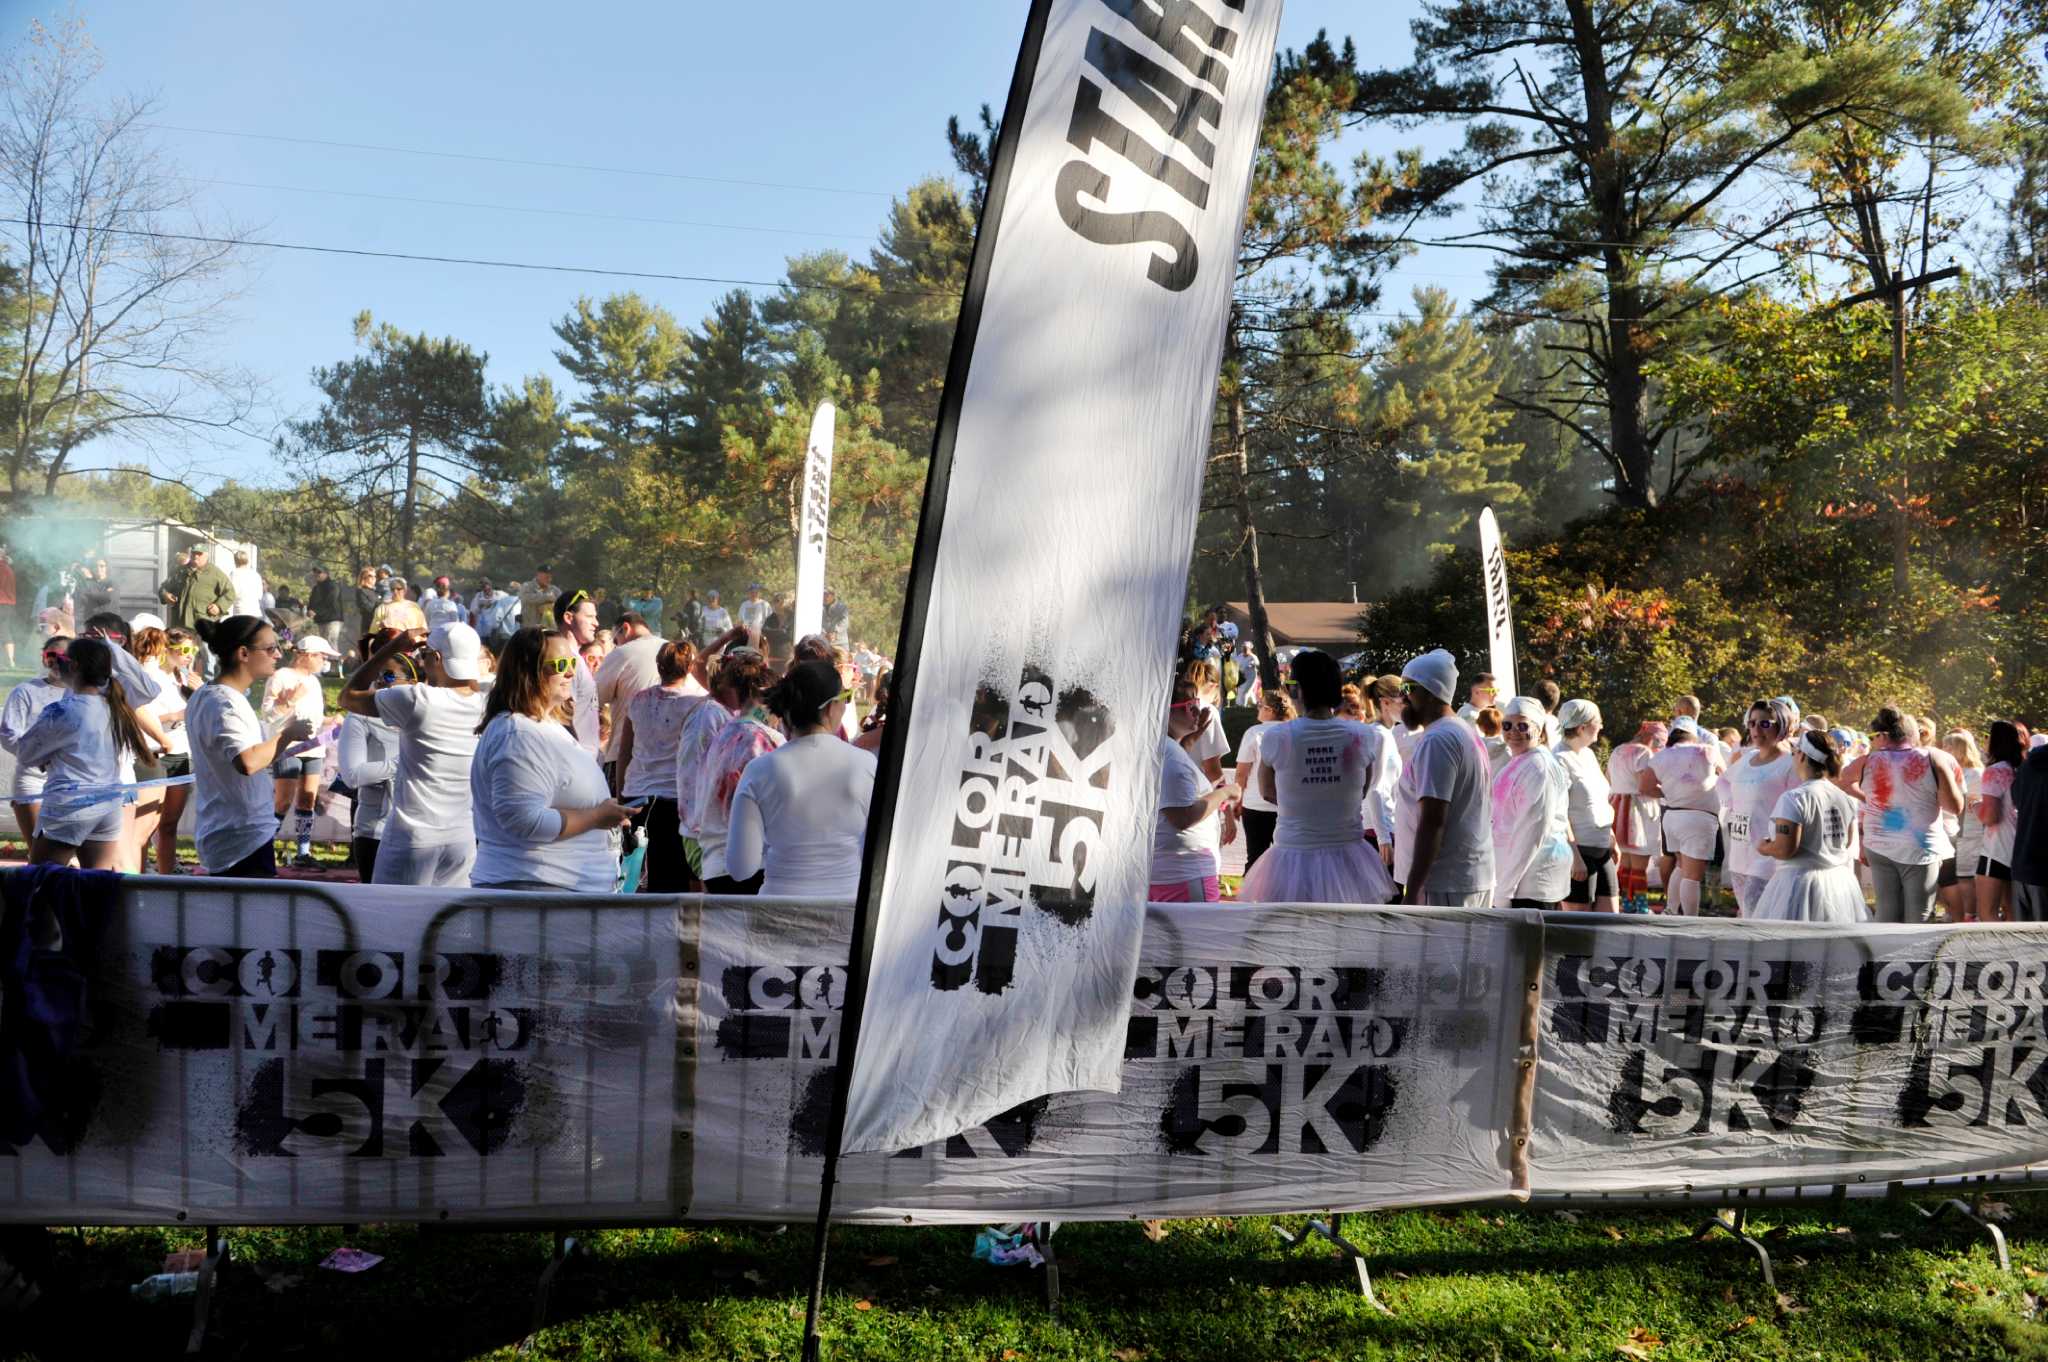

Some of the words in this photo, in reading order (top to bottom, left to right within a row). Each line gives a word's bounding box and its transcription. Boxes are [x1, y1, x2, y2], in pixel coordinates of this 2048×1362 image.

[1055, 0, 1244, 292] STAR
[1305, 756, 1338, 765] HEART
[1307, 746, 1334, 755] MORE
[1310, 766, 1332, 774] LESS
[1301, 775, 1341, 784] ATTACK
[1032, 721, 1117, 895] 5K
[934, 731, 1003, 967] COLOR
[180, 947, 452, 1000] COLOR
[1577, 956, 1773, 1000] COLOR
[1876, 961, 2046, 1001] COLOR
[1984, 1005, 2048, 1043] RA
[280, 1058, 488, 1157] 5K
[1195, 1063, 1363, 1155] 5K
[1637, 1050, 1778, 1134] 5K
[1923, 1046, 2048, 1128] 5K
